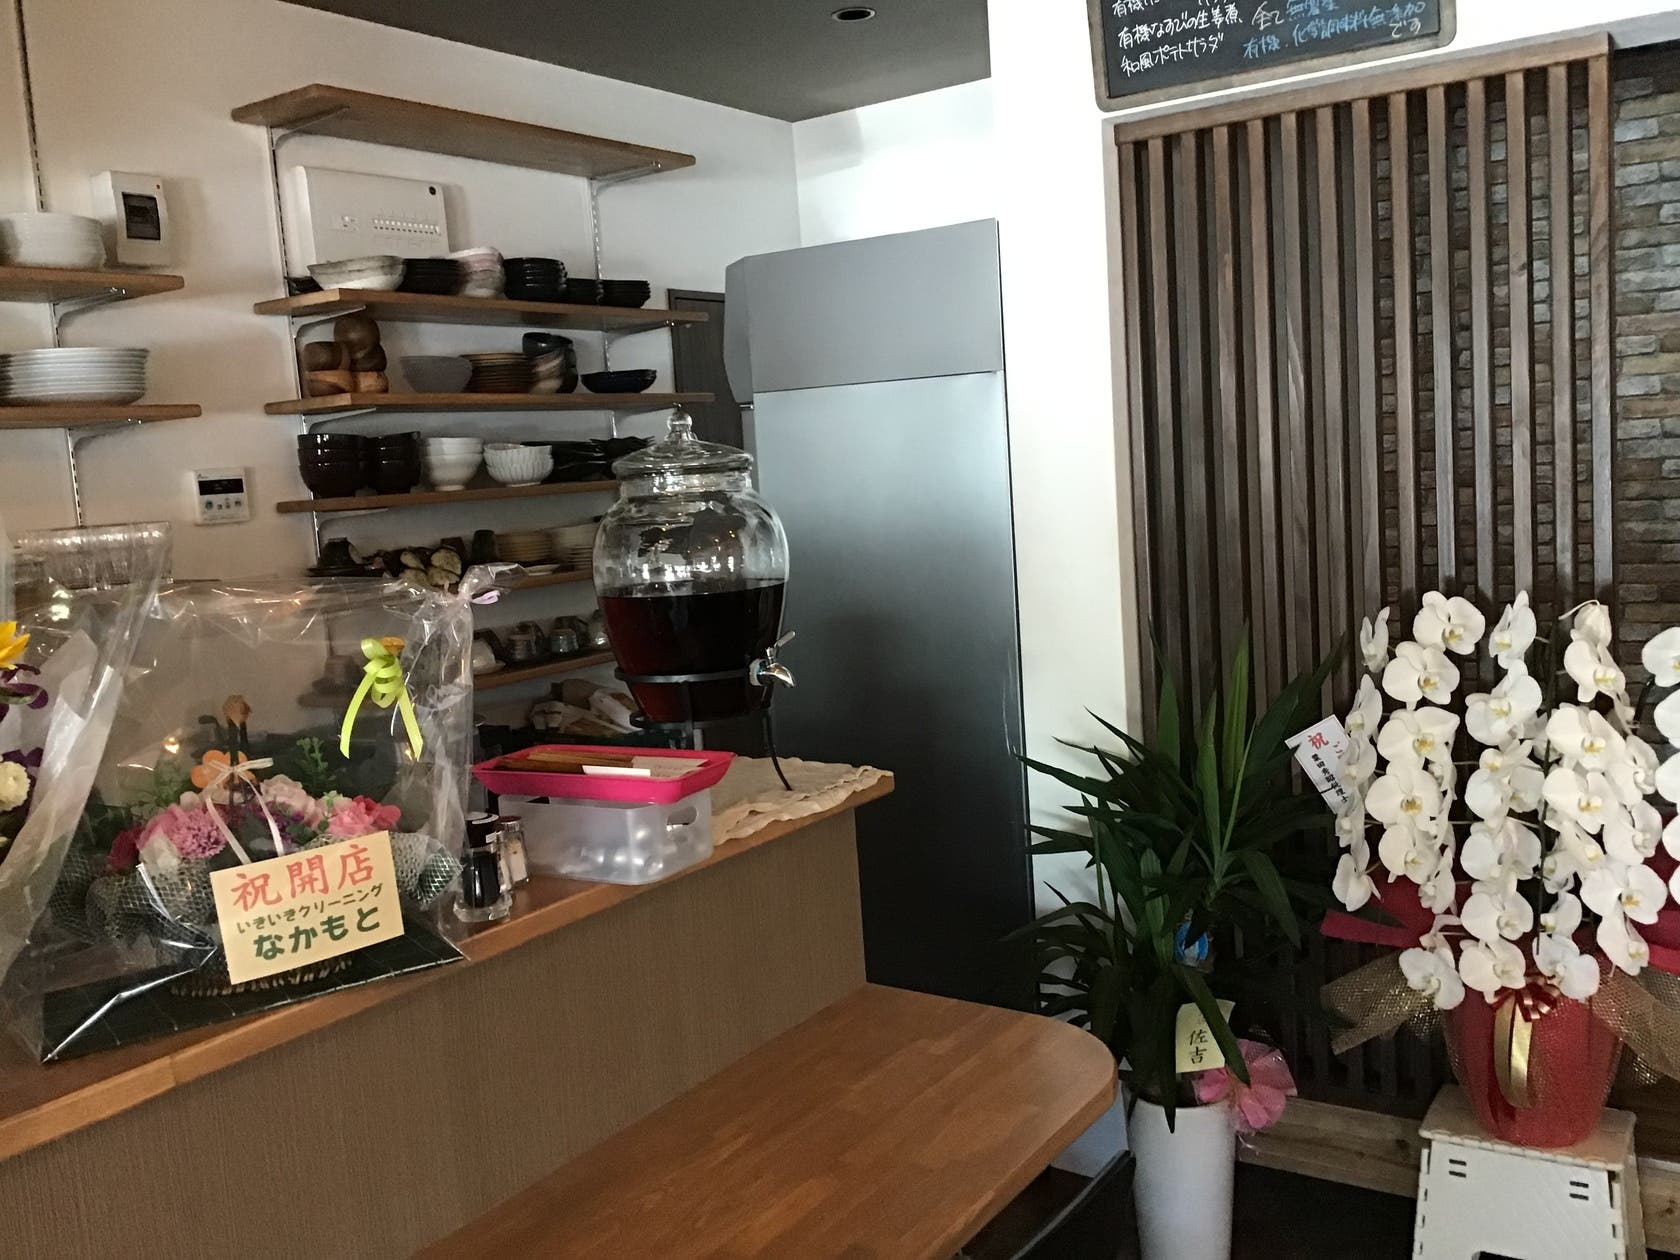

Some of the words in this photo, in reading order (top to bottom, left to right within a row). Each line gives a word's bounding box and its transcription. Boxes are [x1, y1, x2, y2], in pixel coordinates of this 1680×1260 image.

[1308, 732, 1329, 750] 祝
[237, 883, 383, 934] いきいきクリーニング
[253, 906, 380, 960] なかもと
